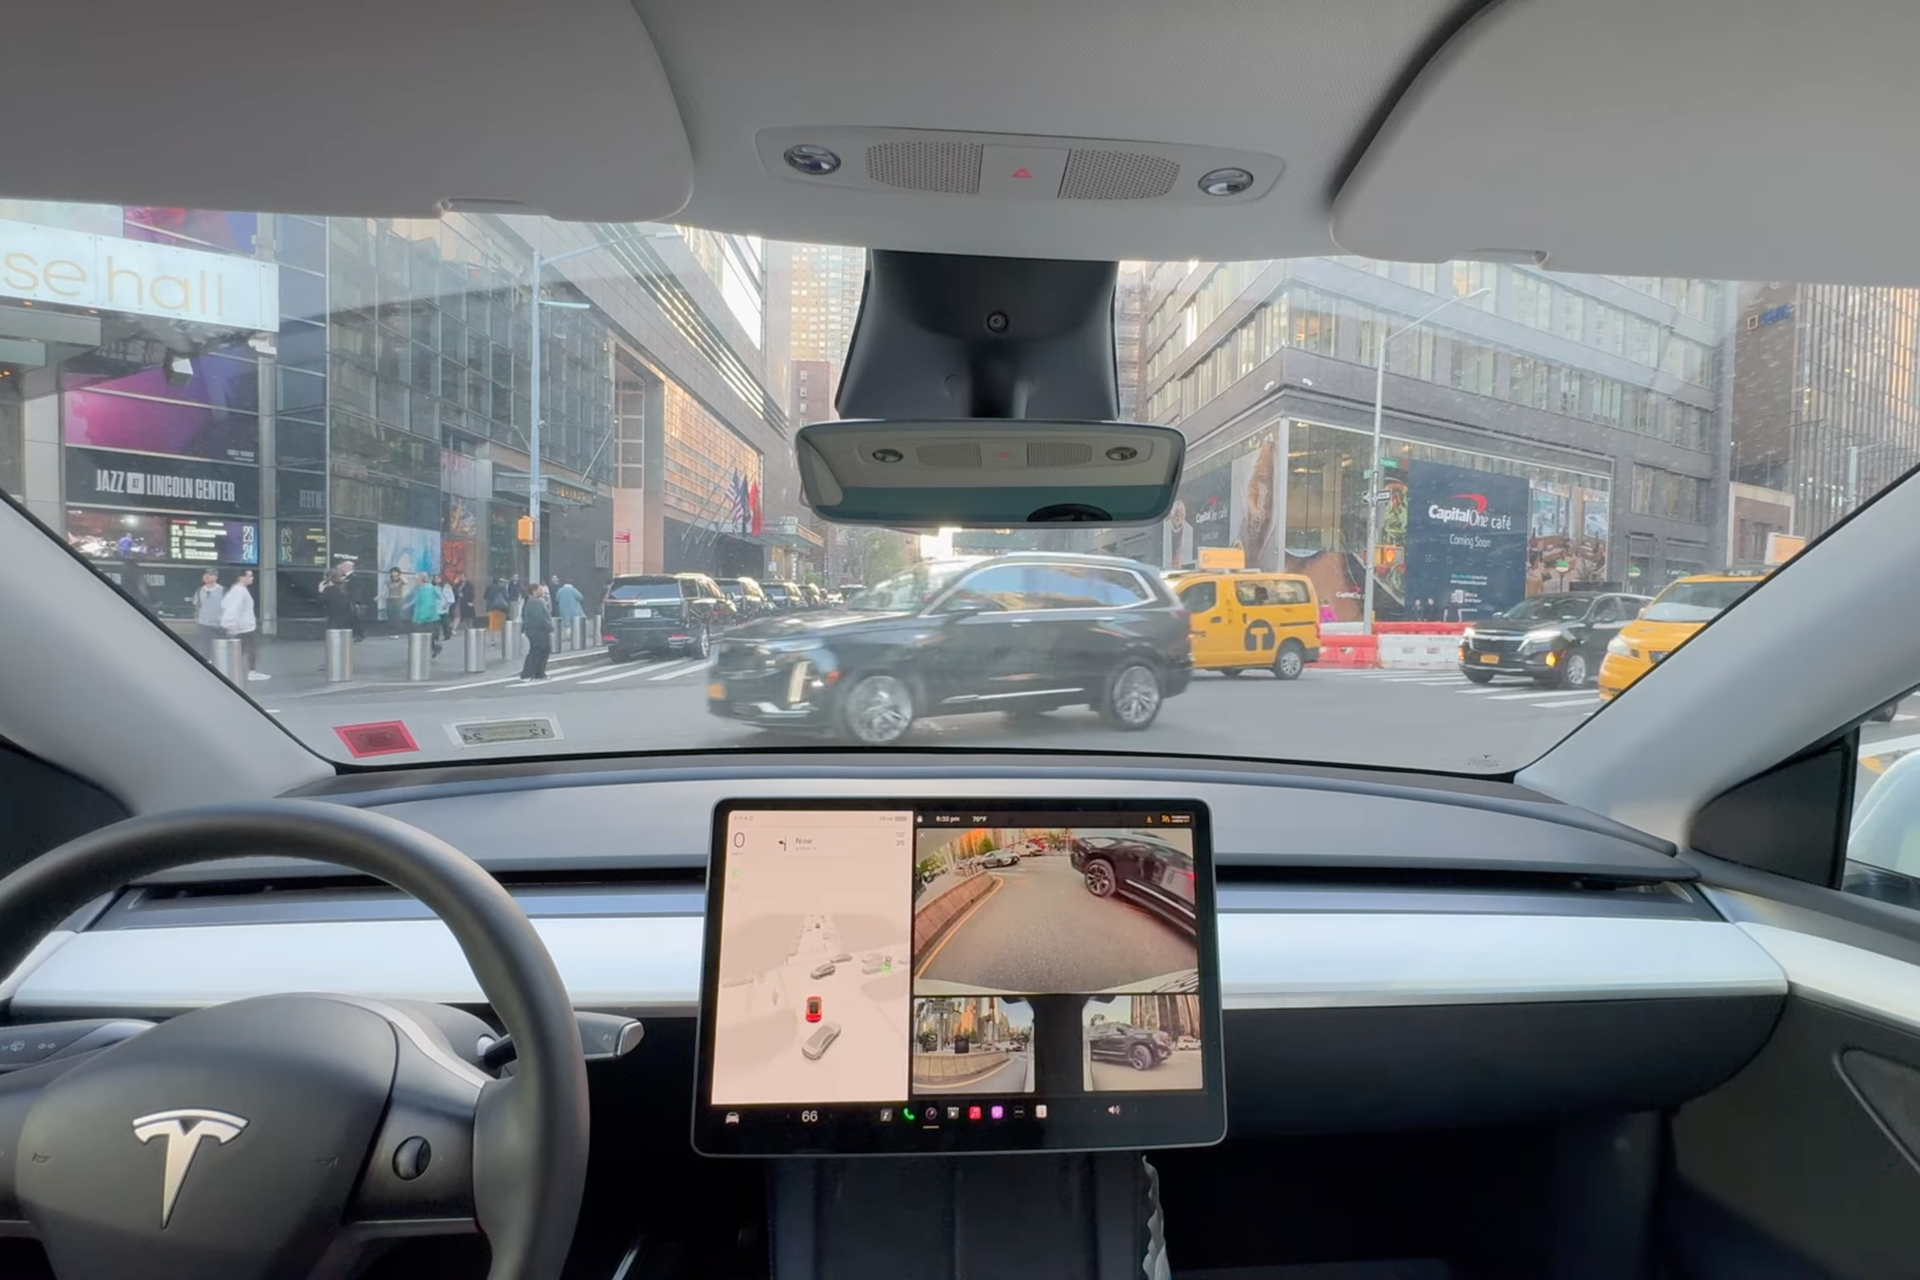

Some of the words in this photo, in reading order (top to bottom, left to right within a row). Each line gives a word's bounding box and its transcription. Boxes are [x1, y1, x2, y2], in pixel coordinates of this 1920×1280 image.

[106, 255, 225, 317] hall
[96, 469, 124, 493] JAZZ
[146, 473, 194, 499] LINCOLN
[195, 478, 235, 502] CENTER
[1490, 514, 1512, 531] café
[243, 525, 254, 543] 23
[1449, 533, 1474, 550] Coming
[1474, 536, 1492, 549] Soon
[243, 543, 254, 561] 24
[733, 831, 746, 849] 0
[795, 837, 813, 845] Now
[801, 1110, 819, 1123] 66
